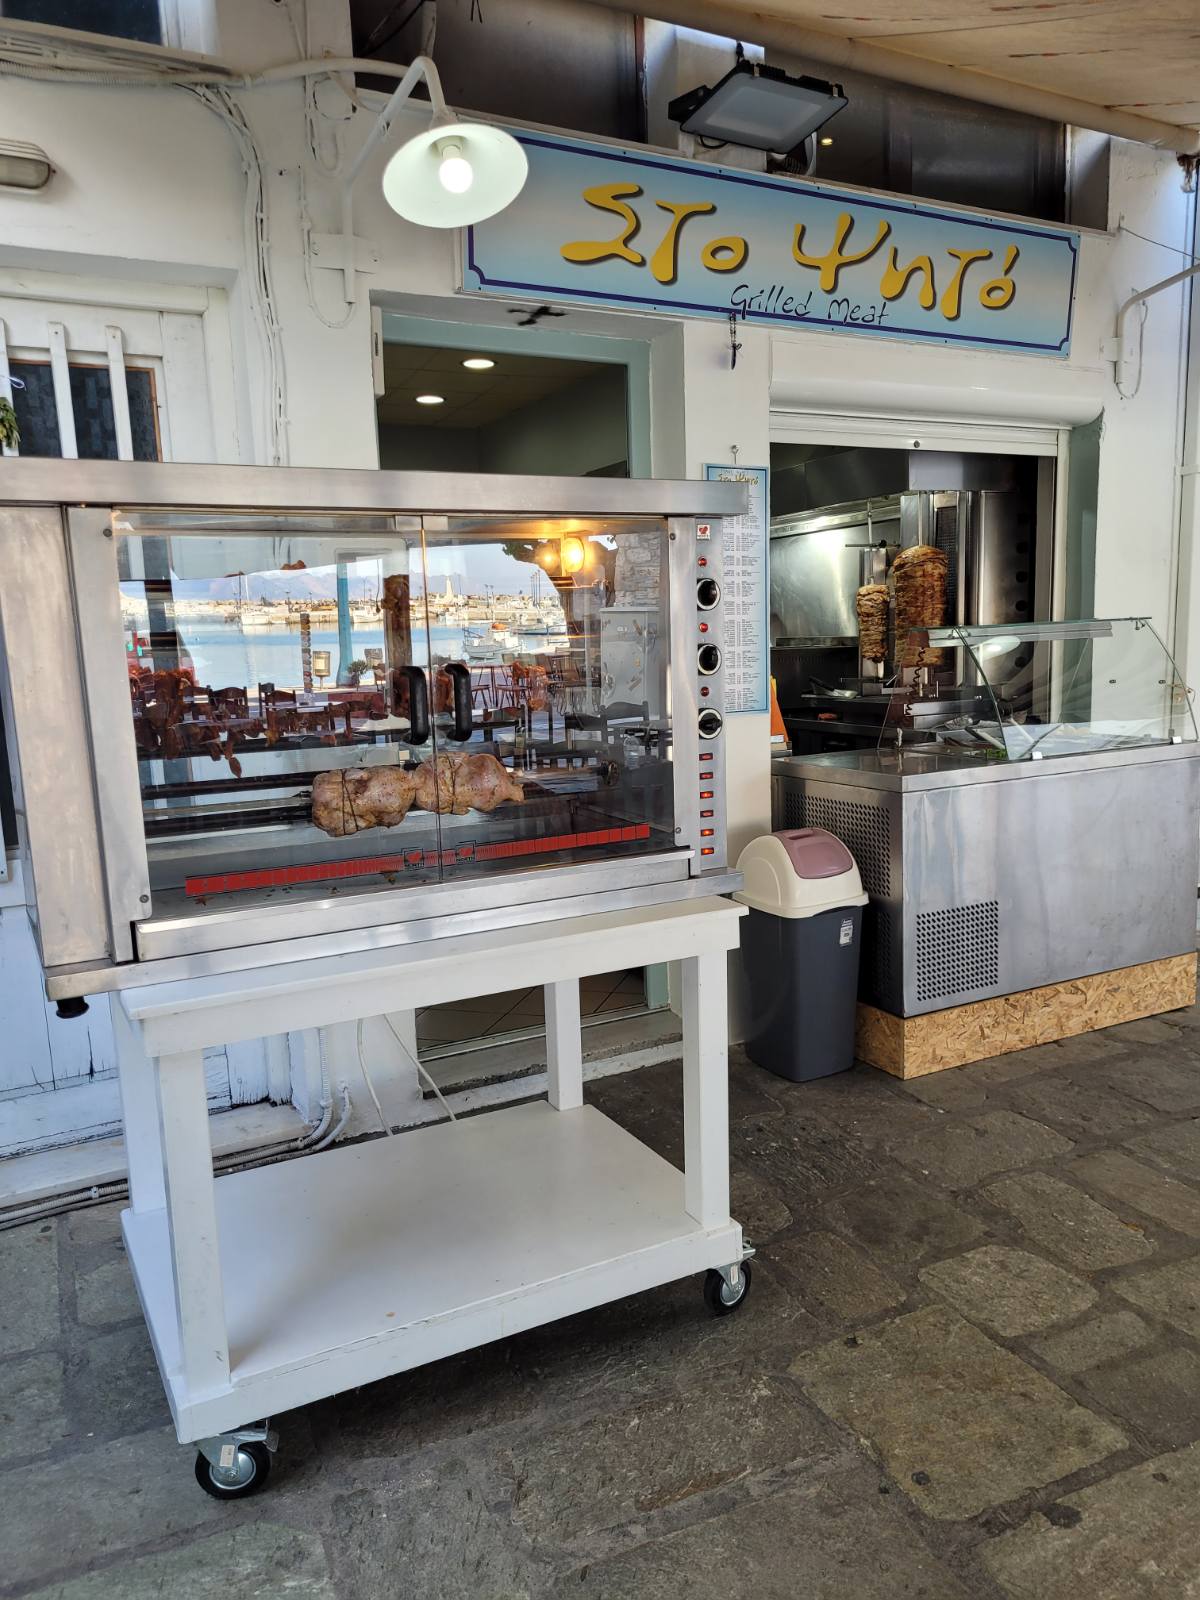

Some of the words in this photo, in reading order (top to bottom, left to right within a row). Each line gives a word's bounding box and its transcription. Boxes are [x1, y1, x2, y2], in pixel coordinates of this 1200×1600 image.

[792, 213, 1019, 320] Ψητό
[730, 284, 813, 320] Grilled
[827, 298, 889, 325] Meat
